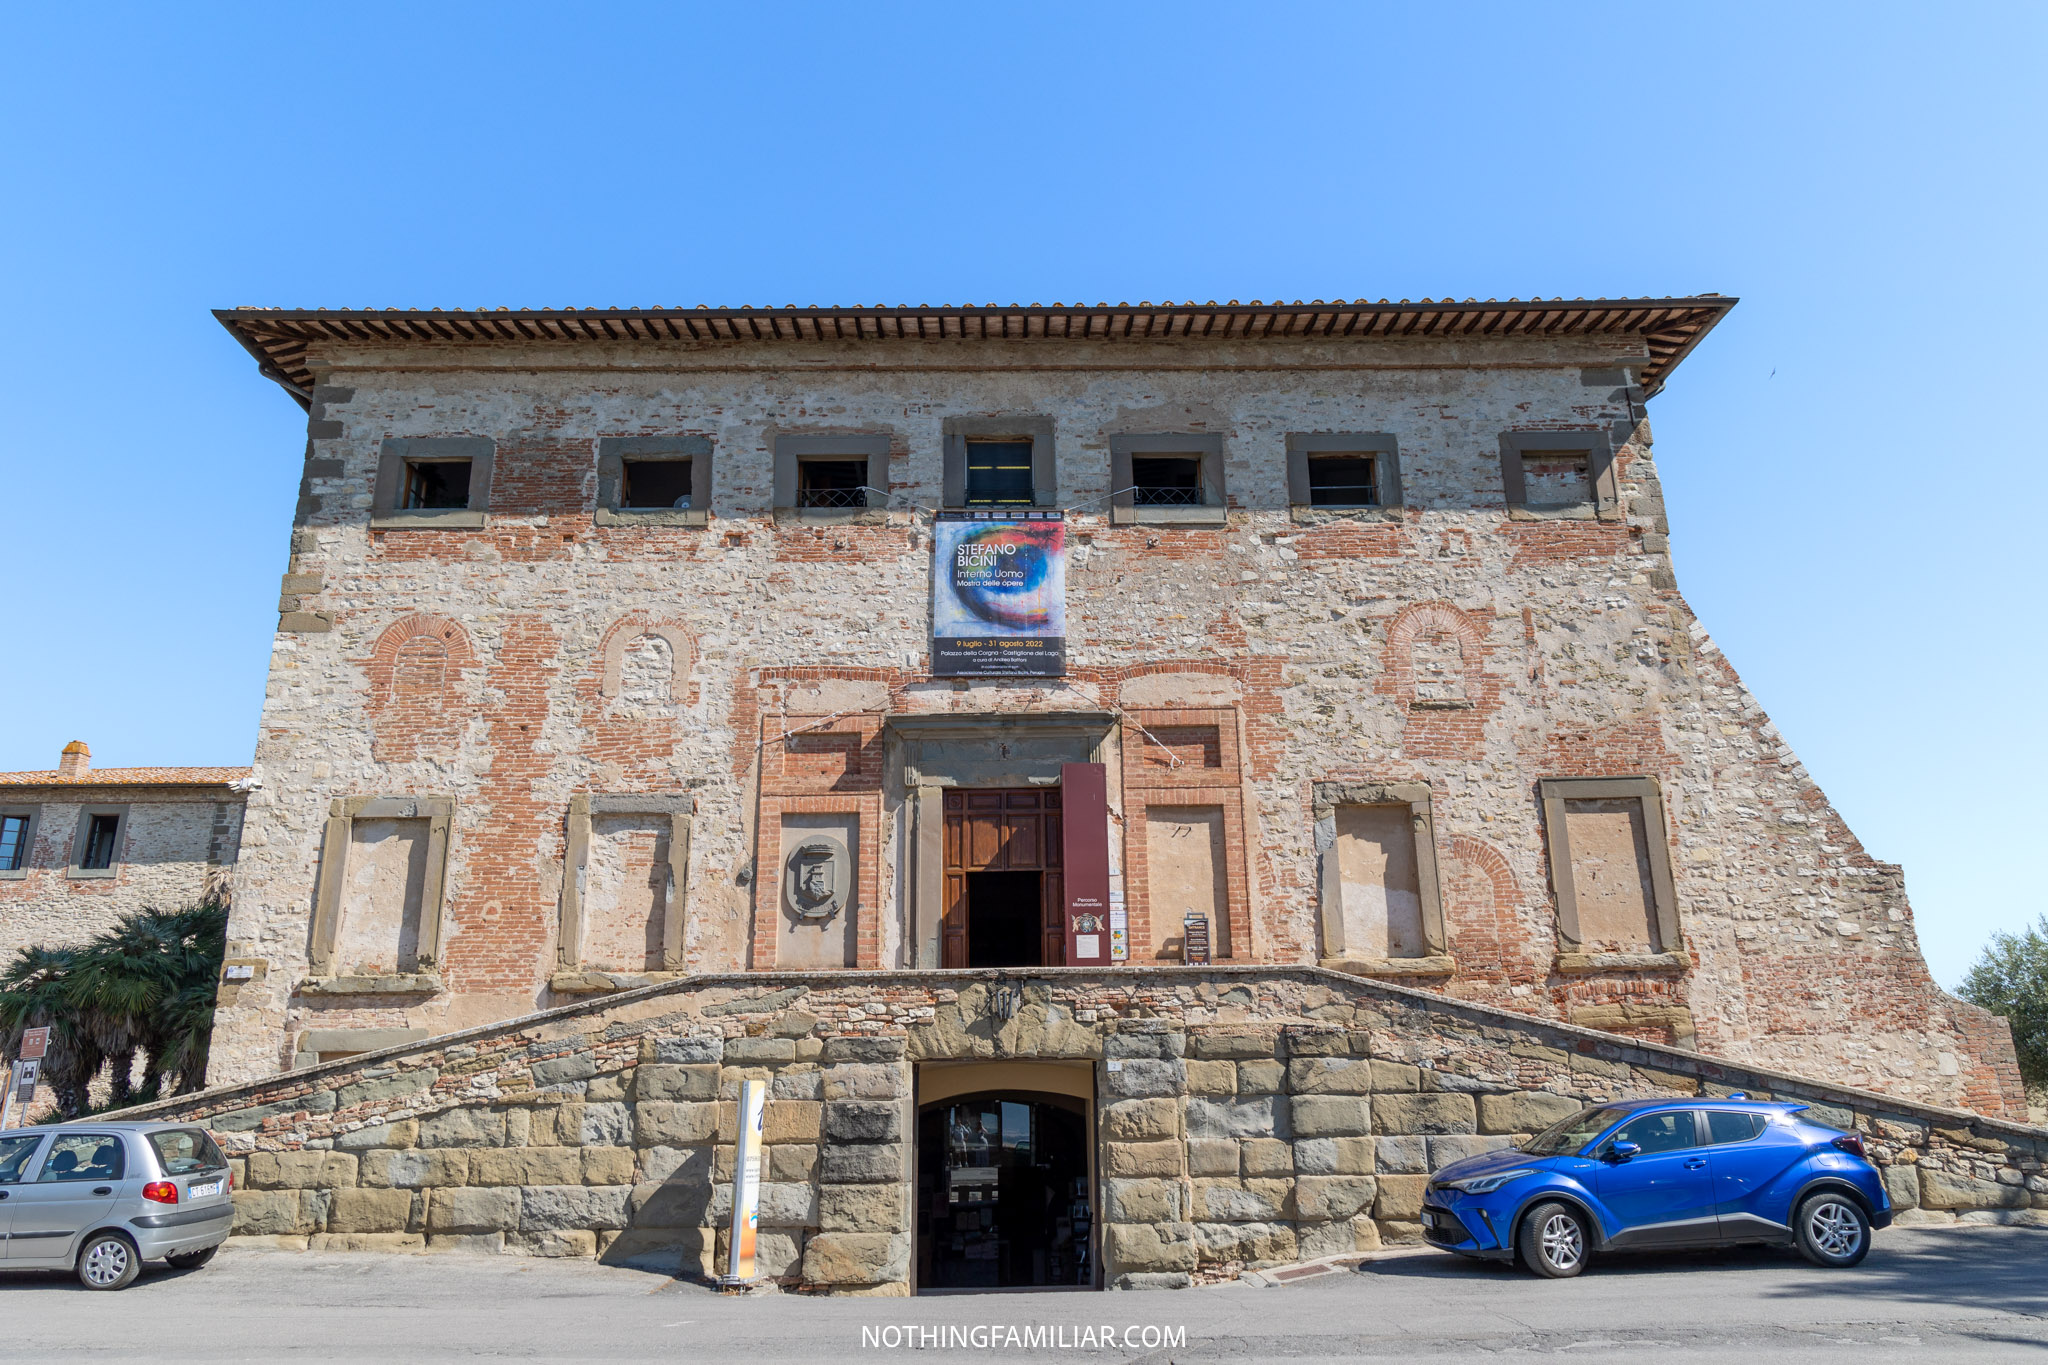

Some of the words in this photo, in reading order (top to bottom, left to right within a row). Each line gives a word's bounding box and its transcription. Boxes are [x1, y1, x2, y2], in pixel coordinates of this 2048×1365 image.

[957, 543, 1017, 555] STEFANO
[957, 555, 997, 567] BICINI
[957, 569, 992, 578] Interno
[994, 569, 1024, 578] Uomo
[963, 640, 982, 648] luglio
[999, 640, 1024, 648] agosto
